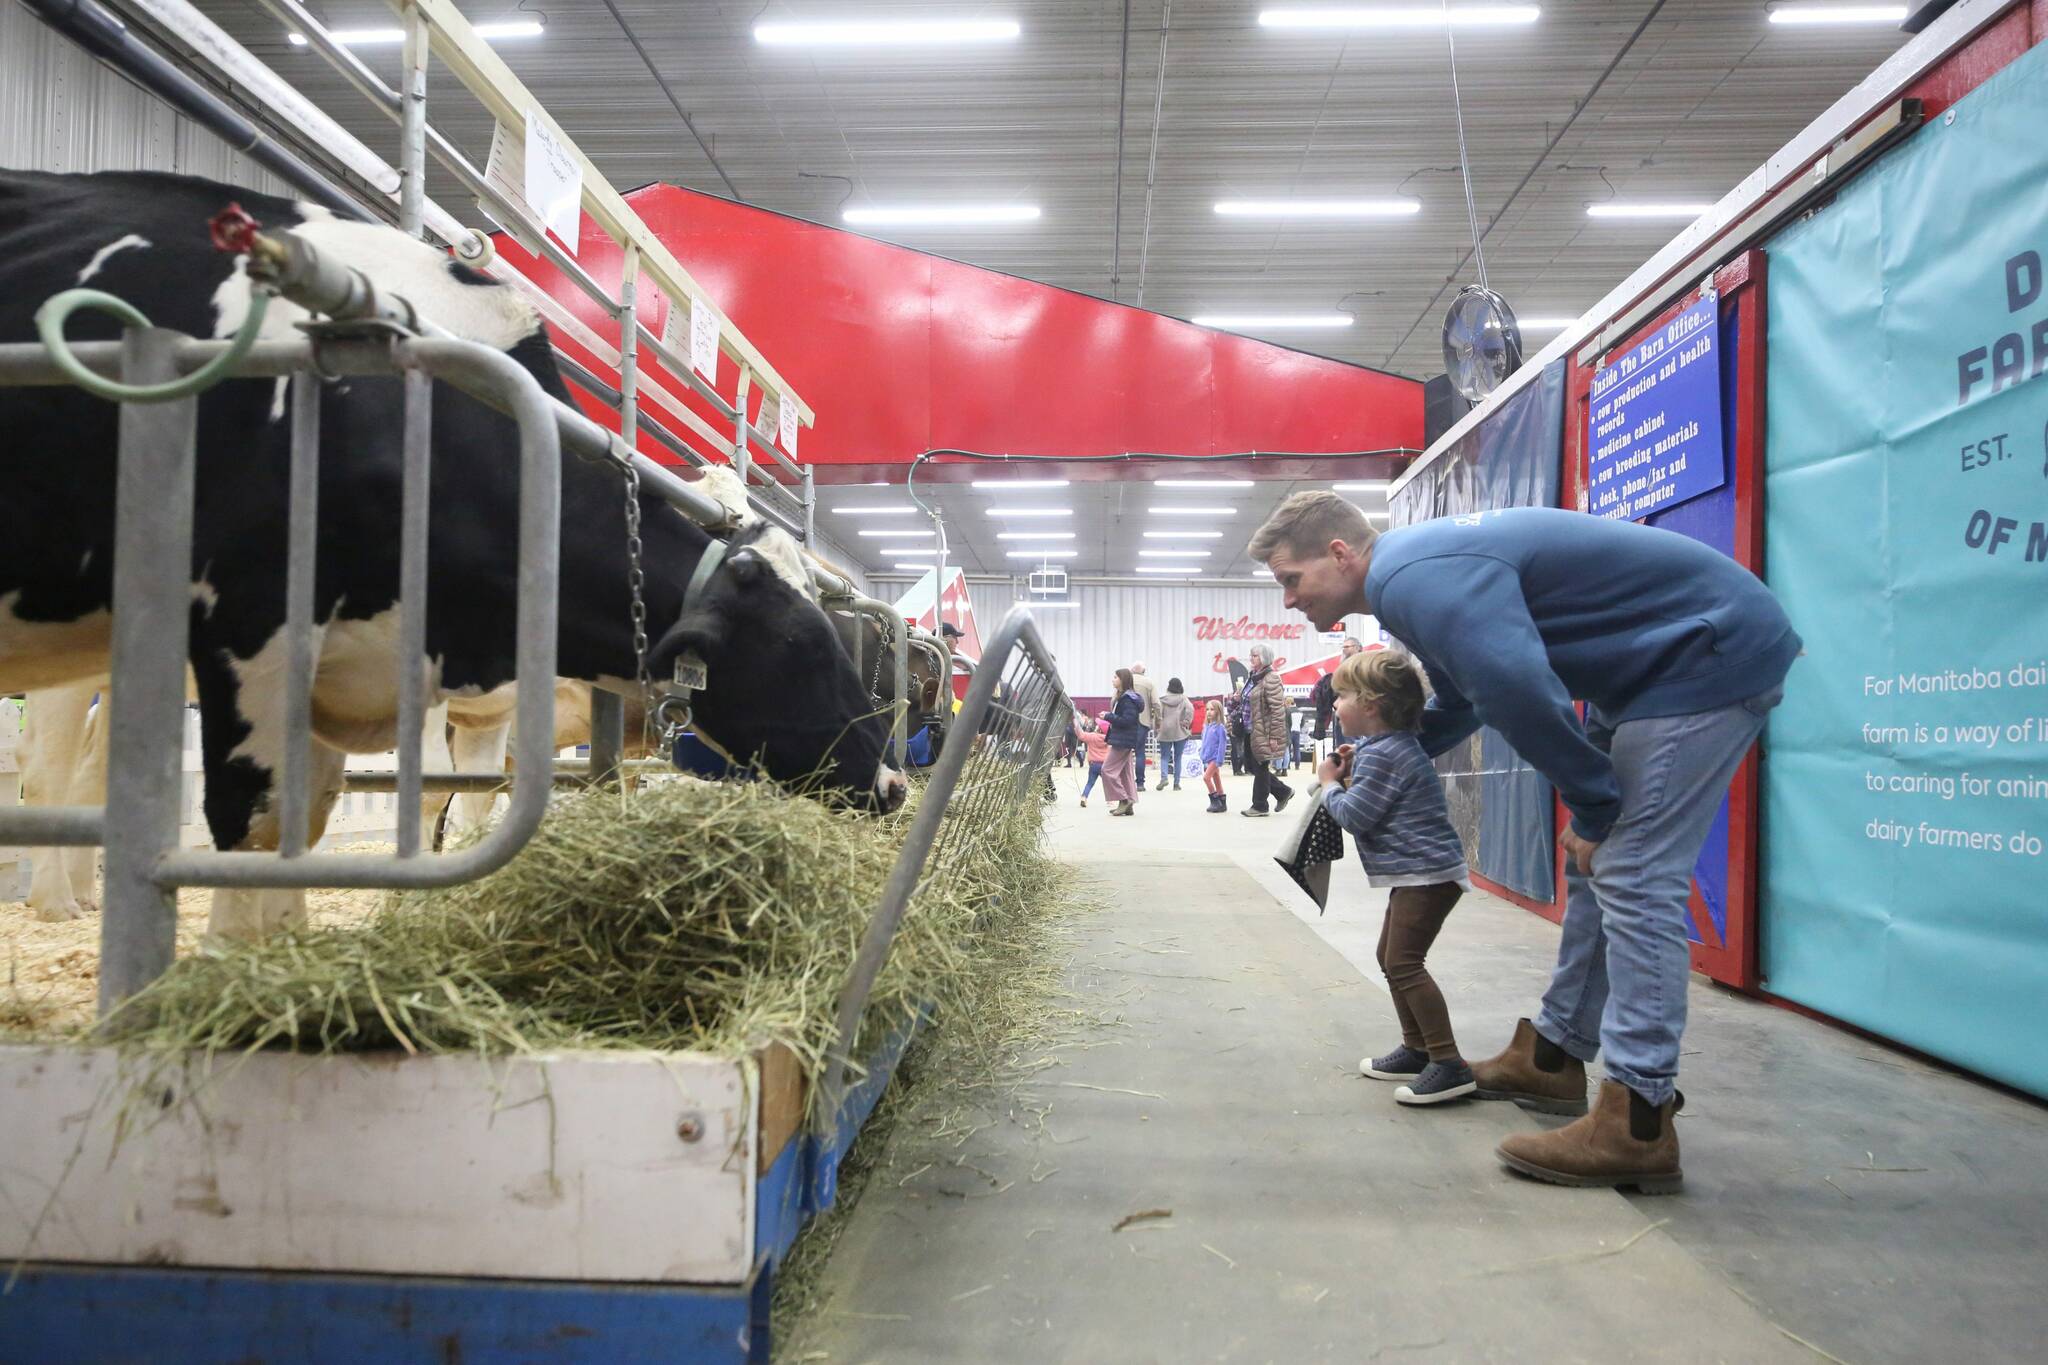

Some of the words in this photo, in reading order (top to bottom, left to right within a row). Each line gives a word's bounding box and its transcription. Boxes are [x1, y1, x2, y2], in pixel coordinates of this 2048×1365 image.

[1594, 369, 1618, 397] Inside
[1621, 357, 1637, 377] The
[1641, 337, 1664, 364] Barn
[1668, 312, 1711, 344] Office...
[1597, 403, 1611, 420] cow
[1614, 374, 1657, 413] production
[1660, 356, 1676, 382] and
[1680, 335, 1711, 368] health
[1597, 411, 1625, 438] records
[1597, 433, 1632, 461] medicine
[1634, 410, 1665, 440] cabinet
[1598, 467, 1613, 483] cow
[1615, 447, 1652, 475] breeding
[1654, 421, 1698, 456] materials
[1960, 433, 2013, 472] EST.
[1600, 487, 1619, 507] desk,
[1622, 466, 1666, 500] phone/fax
[1669, 452, 1686, 475] and
[1634, 483, 1675, 511] computer
[1964, 509, 2018, 555] OF
[1193, 615, 1306, 640] Welcome
[1864, 676, 1893, 696] For
[1899, 667, 2001, 694] Manitoba
[1862, 722, 1908, 743] farm
[1914, 722, 1929, 743] is
[1934, 726, 1948, 743] a
[1954, 724, 2000, 748] way
[2006, 718, 2034, 743] of
[1865, 770, 1885, 791] to
[1889, 772, 1955, 800] caring
[1960, 772, 1991, 796] for
[1865, 817, 1914, 847] dairy
[1918, 822, 2003, 851] farmers
[2009, 829, 2042, 855] do
